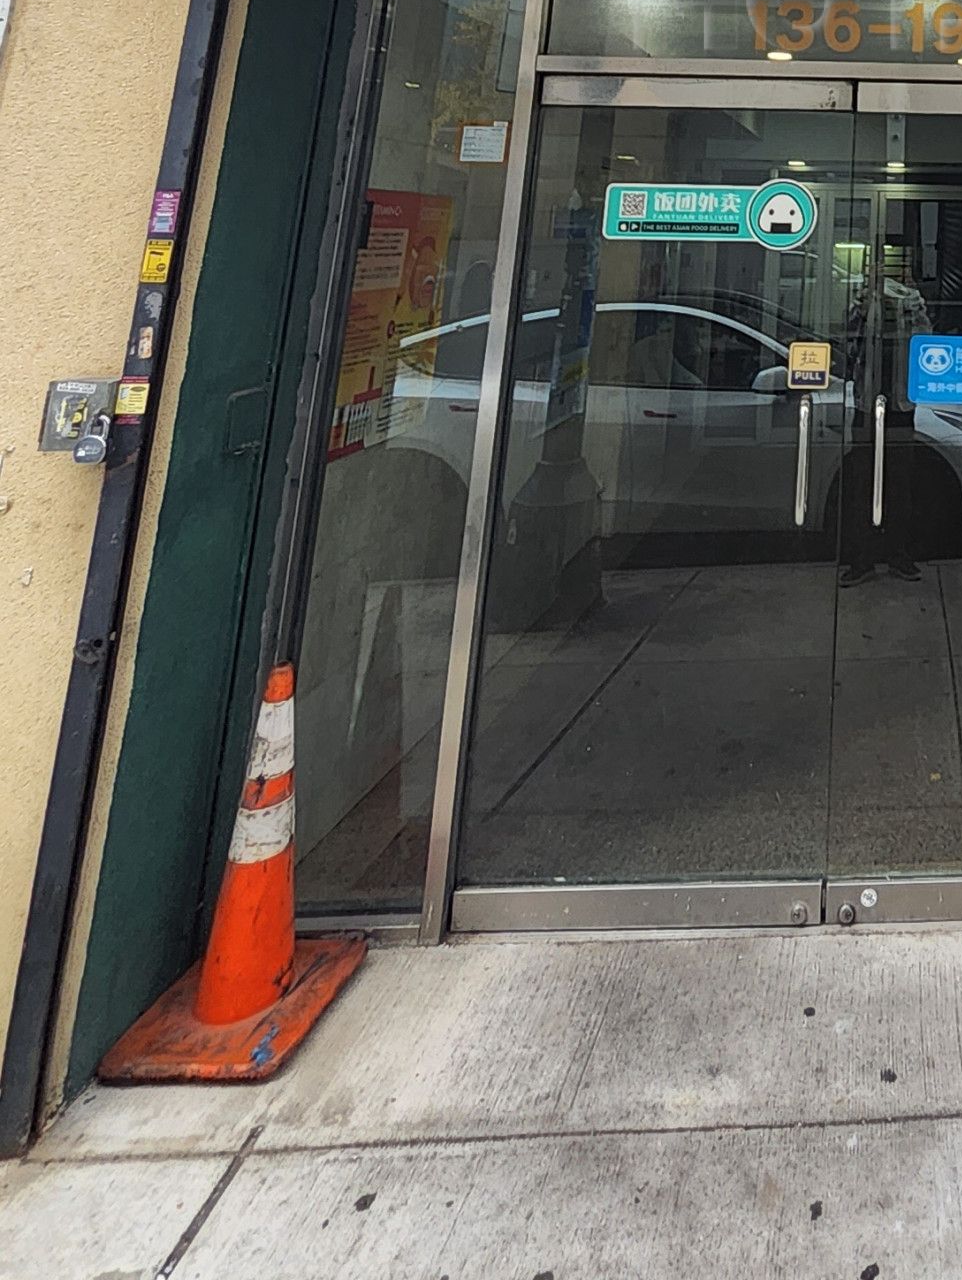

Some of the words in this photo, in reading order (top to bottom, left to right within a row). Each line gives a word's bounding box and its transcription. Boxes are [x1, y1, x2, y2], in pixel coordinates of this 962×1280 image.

[654, 191, 741, 213] 饭团外卖
[799, 351, 819, 367] 拉
[795, 371, 822, 382] PULL
